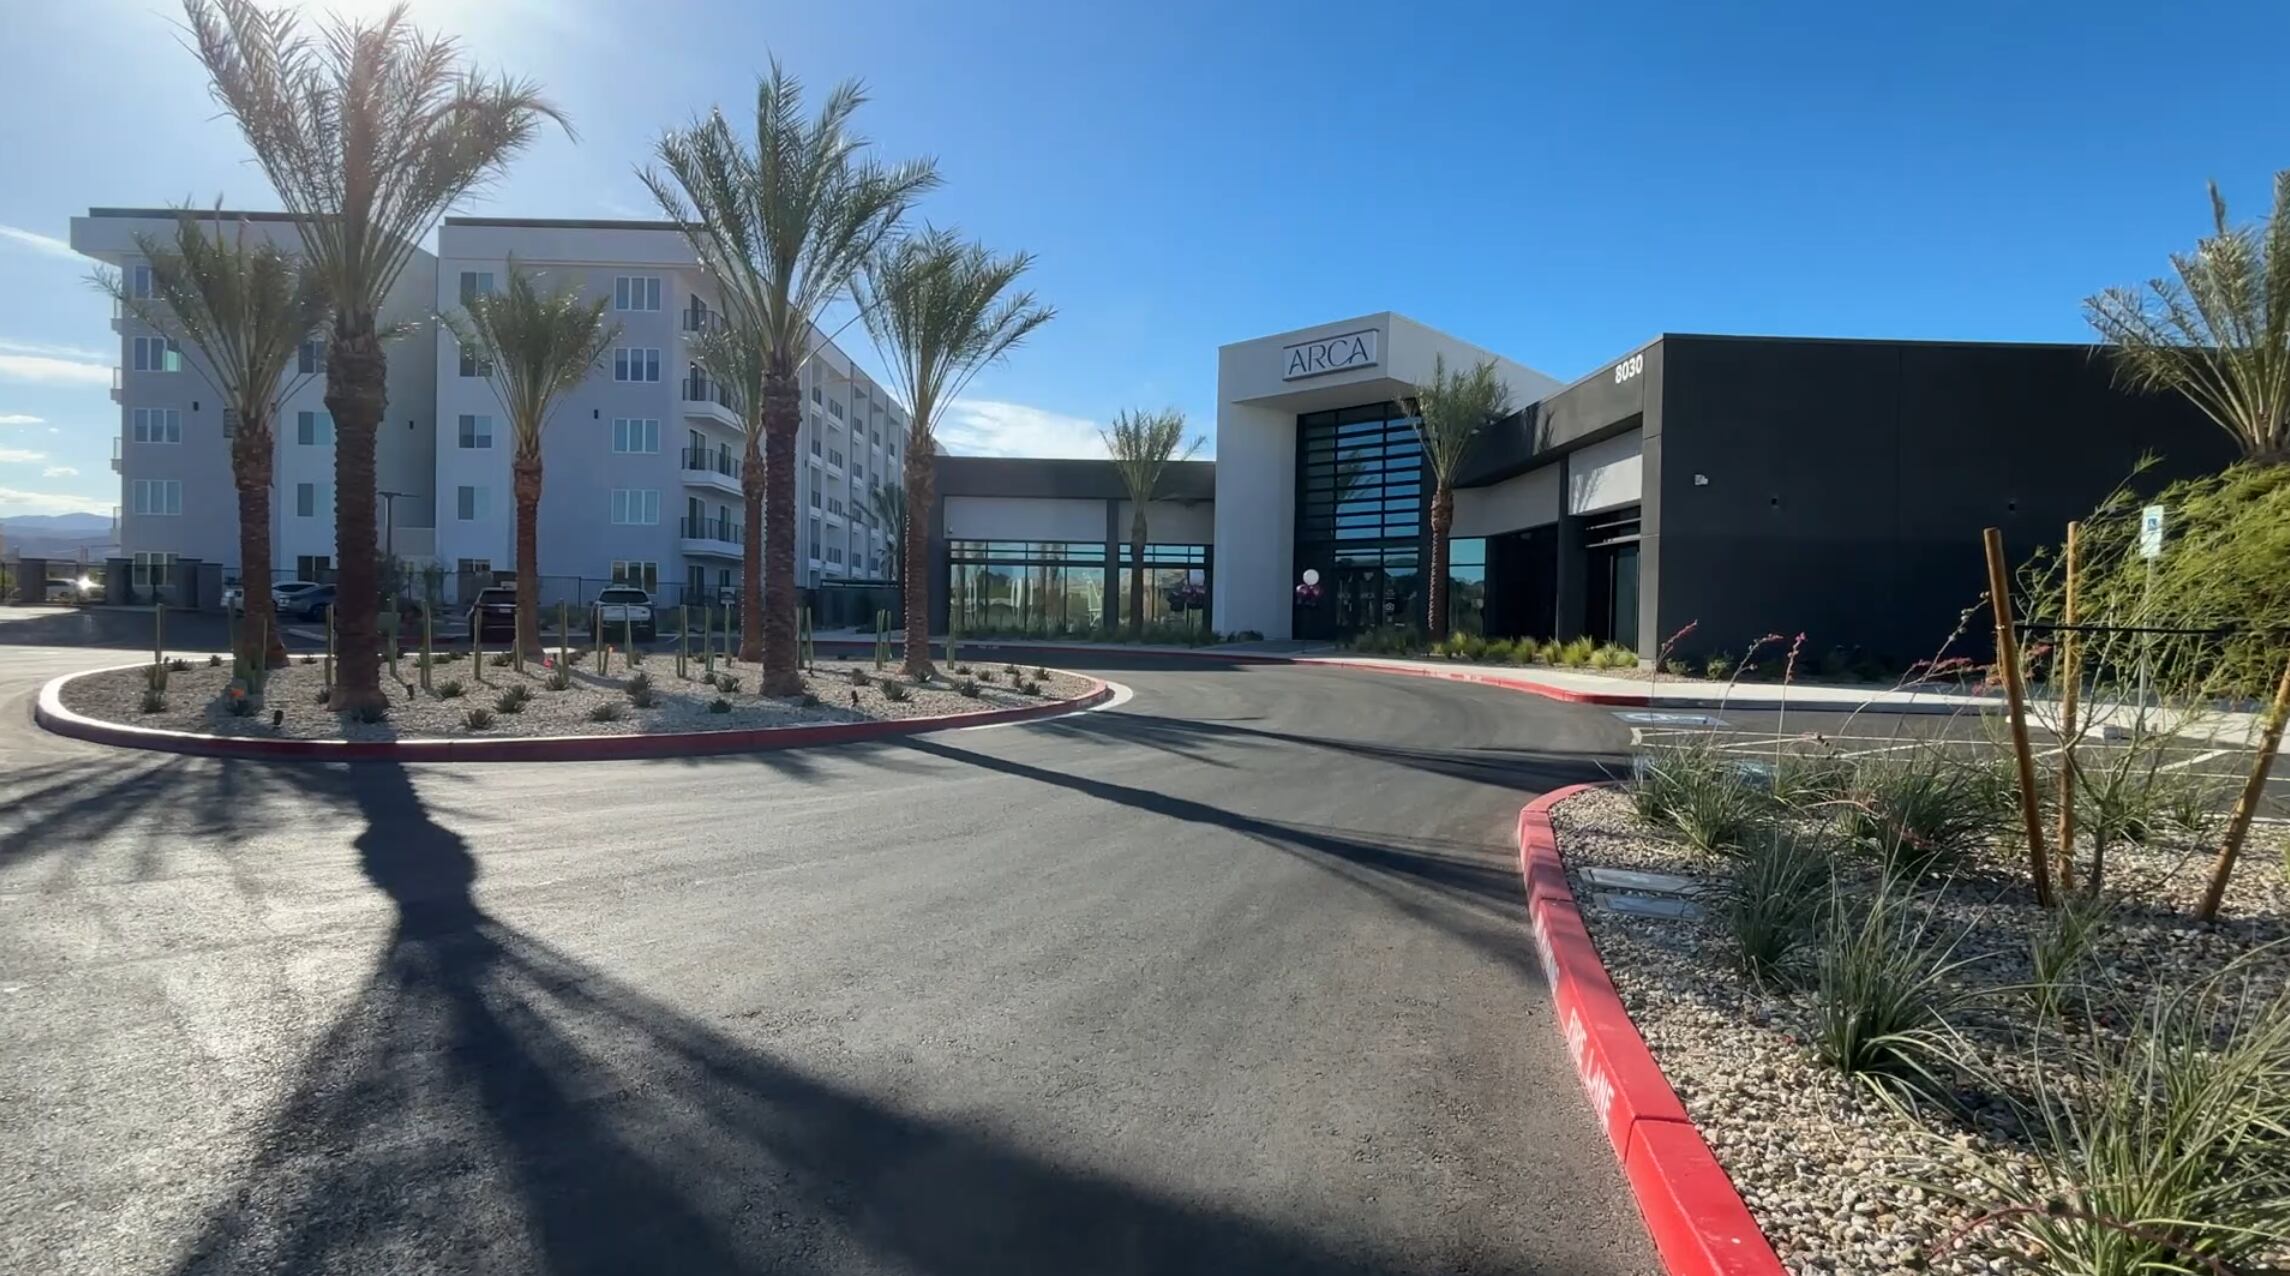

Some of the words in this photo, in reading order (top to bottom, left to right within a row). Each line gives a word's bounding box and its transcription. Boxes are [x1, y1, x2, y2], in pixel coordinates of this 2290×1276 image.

[1288, 336, 1369, 375] ARCA
[1615, 353, 1644, 384] 8030
[1566, 1005, 1588, 1069] FIRE
[1584, 1047, 1616, 1134] LANE
